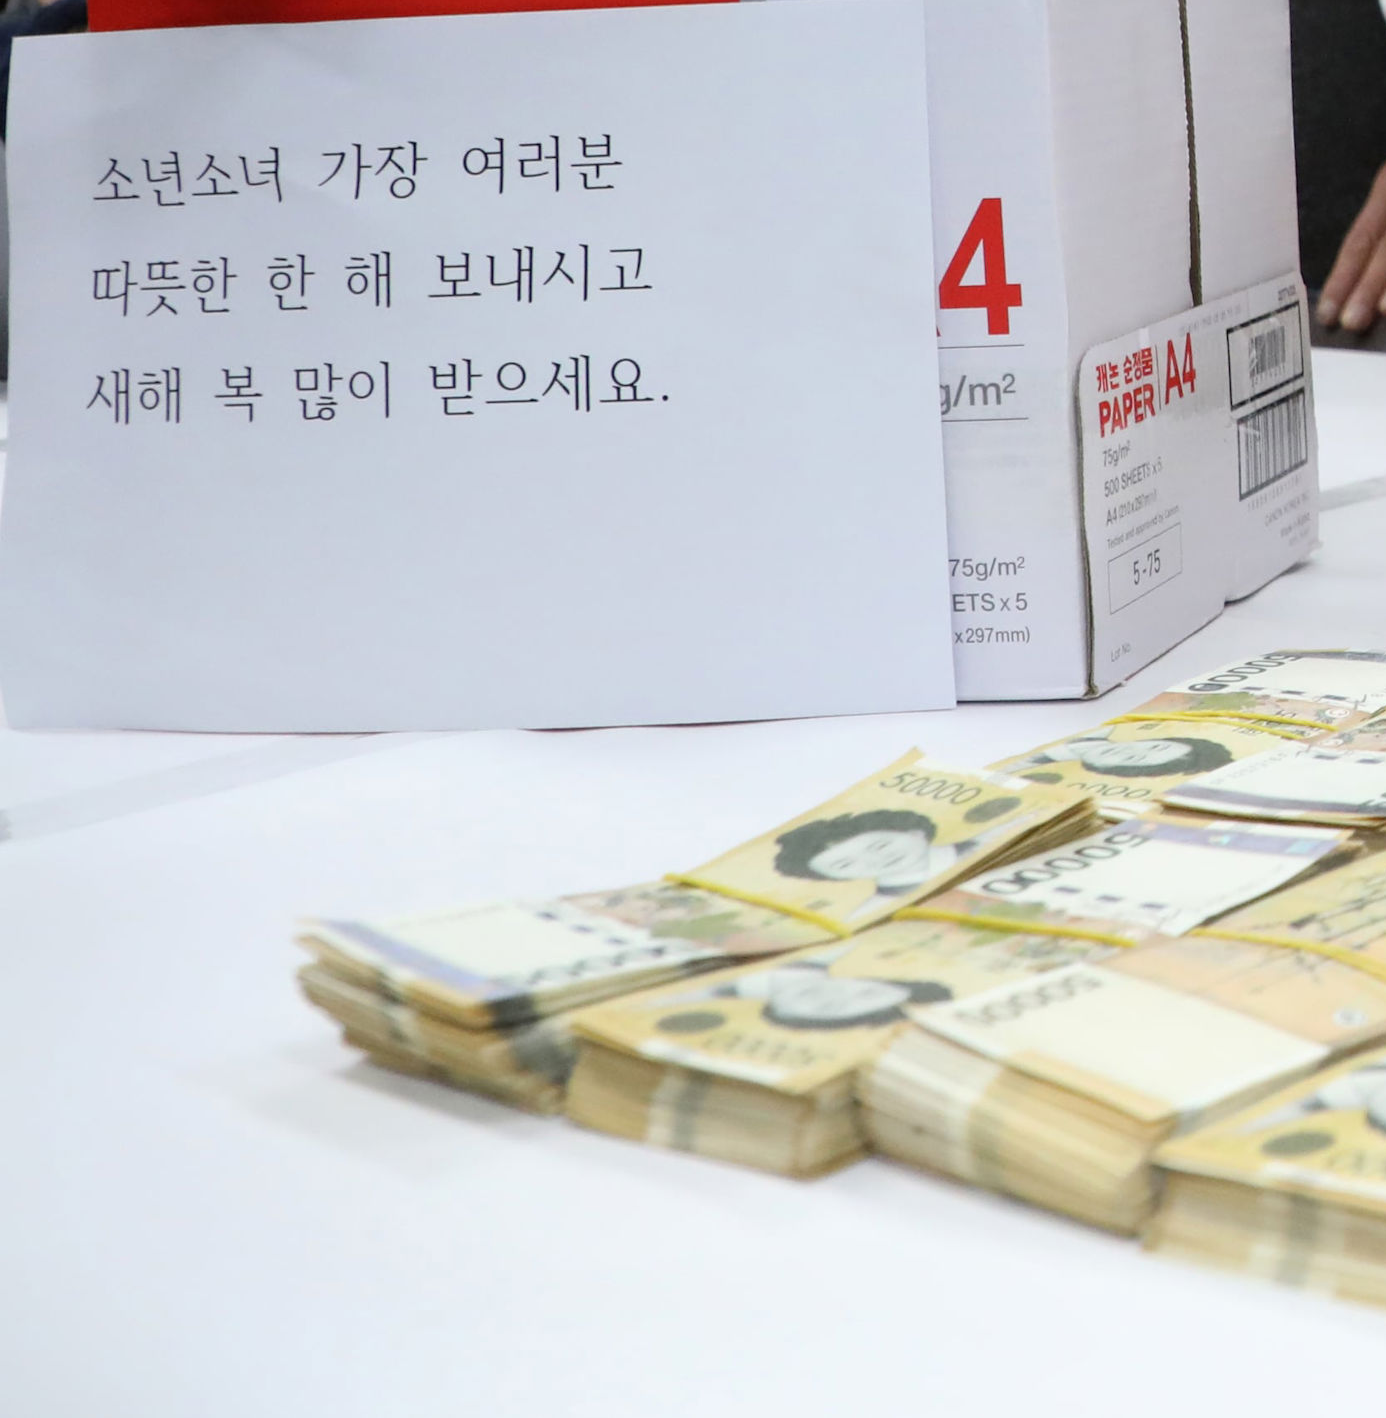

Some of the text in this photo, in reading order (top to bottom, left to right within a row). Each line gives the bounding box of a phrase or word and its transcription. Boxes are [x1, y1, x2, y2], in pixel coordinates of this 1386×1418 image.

[92, 133, 623, 207] 소년소녀 가장 여러분
[92, 243, 653, 317] 따뜻한 한 해 보내시고
[936, 198, 1022, 337] 4
[86, 354, 669, 425] 새해 복 많이 받으세요.
[1095, 347, 1153, 393] 캐논 순정품
[1165, 332, 1197, 405] A4
[1098, 383, 1156, 439] PAPER
[1104, 477, 1120, 497] 500
[1121, 462, 1150, 490] SHEETS
[1106, 507, 1118, 526] A4
[948, 556, 1025, 581] 75g/m²
[879, 772, 983, 805] 50000
[981, 832, 1151, 895] 50000
